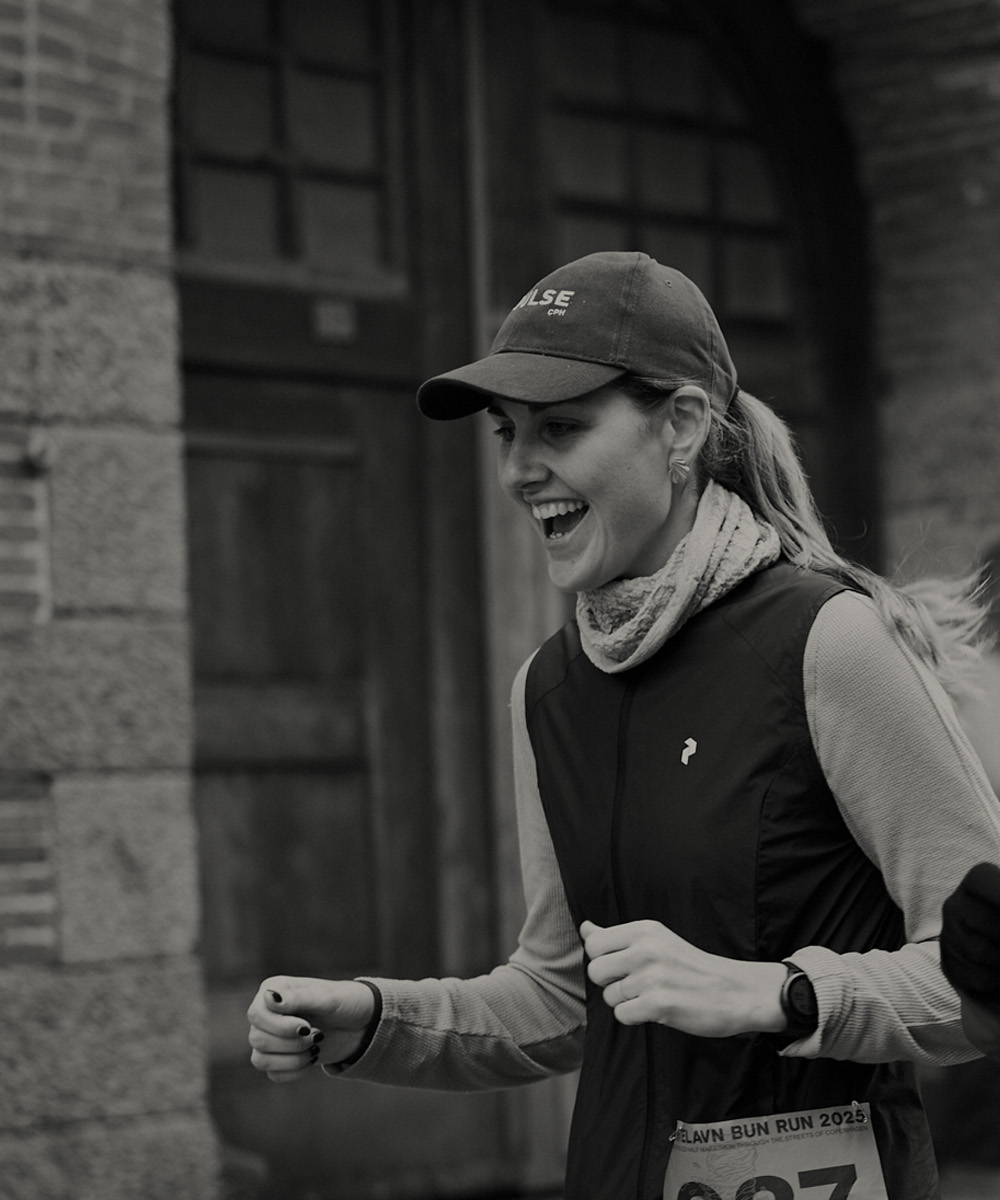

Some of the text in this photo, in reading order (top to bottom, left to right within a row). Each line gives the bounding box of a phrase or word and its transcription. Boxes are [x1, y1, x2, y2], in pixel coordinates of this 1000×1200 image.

[512, 288, 575, 311] ULSE
[547, 308, 566, 316] CPH
[730, 1121, 771, 1141] BUN
[775, 1115, 815, 1134] RUN
[818, 1108, 867, 1128] 2025
[785, 1132, 815, 1142] STREETS
